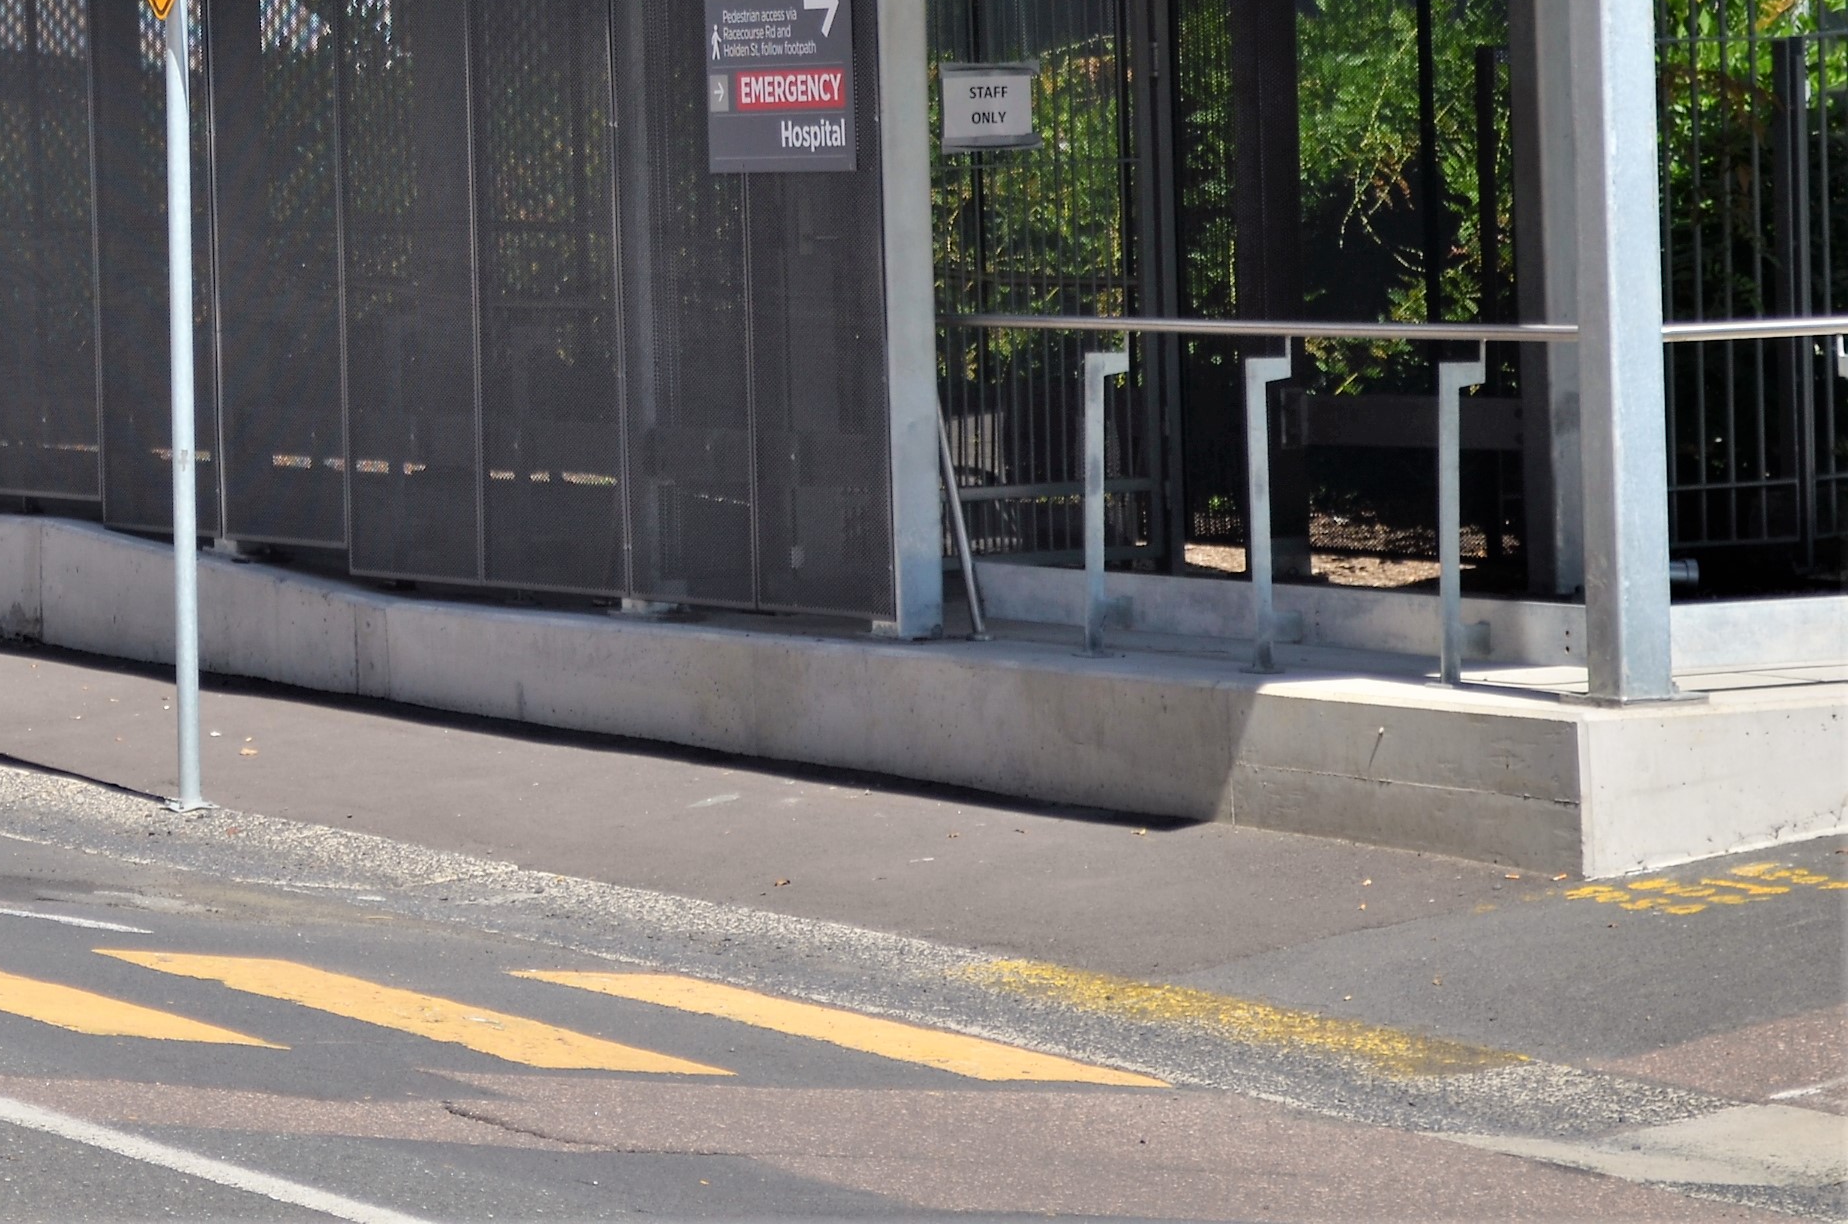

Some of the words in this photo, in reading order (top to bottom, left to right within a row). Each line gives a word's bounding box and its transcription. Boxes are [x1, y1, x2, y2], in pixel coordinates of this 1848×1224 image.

[722, 8, 760, 24] Pedestrian
[761, 9, 785, 22] access
[785, 7, 797, 21] via
[723, 26, 764, 40] Racecourse
[765, 25, 776, 38] Rd
[777, 24, 791, 38] and
[723, 43, 750, 57] Holden
[761, 41, 784, 56] follow
[784, 40, 817, 56] footpath
[740, 73, 842, 104] EMERGENCY
[969, 86, 1008, 99] STAFF
[971, 111, 1007, 125] ONLY
[781, 118, 847, 153] Hospital
